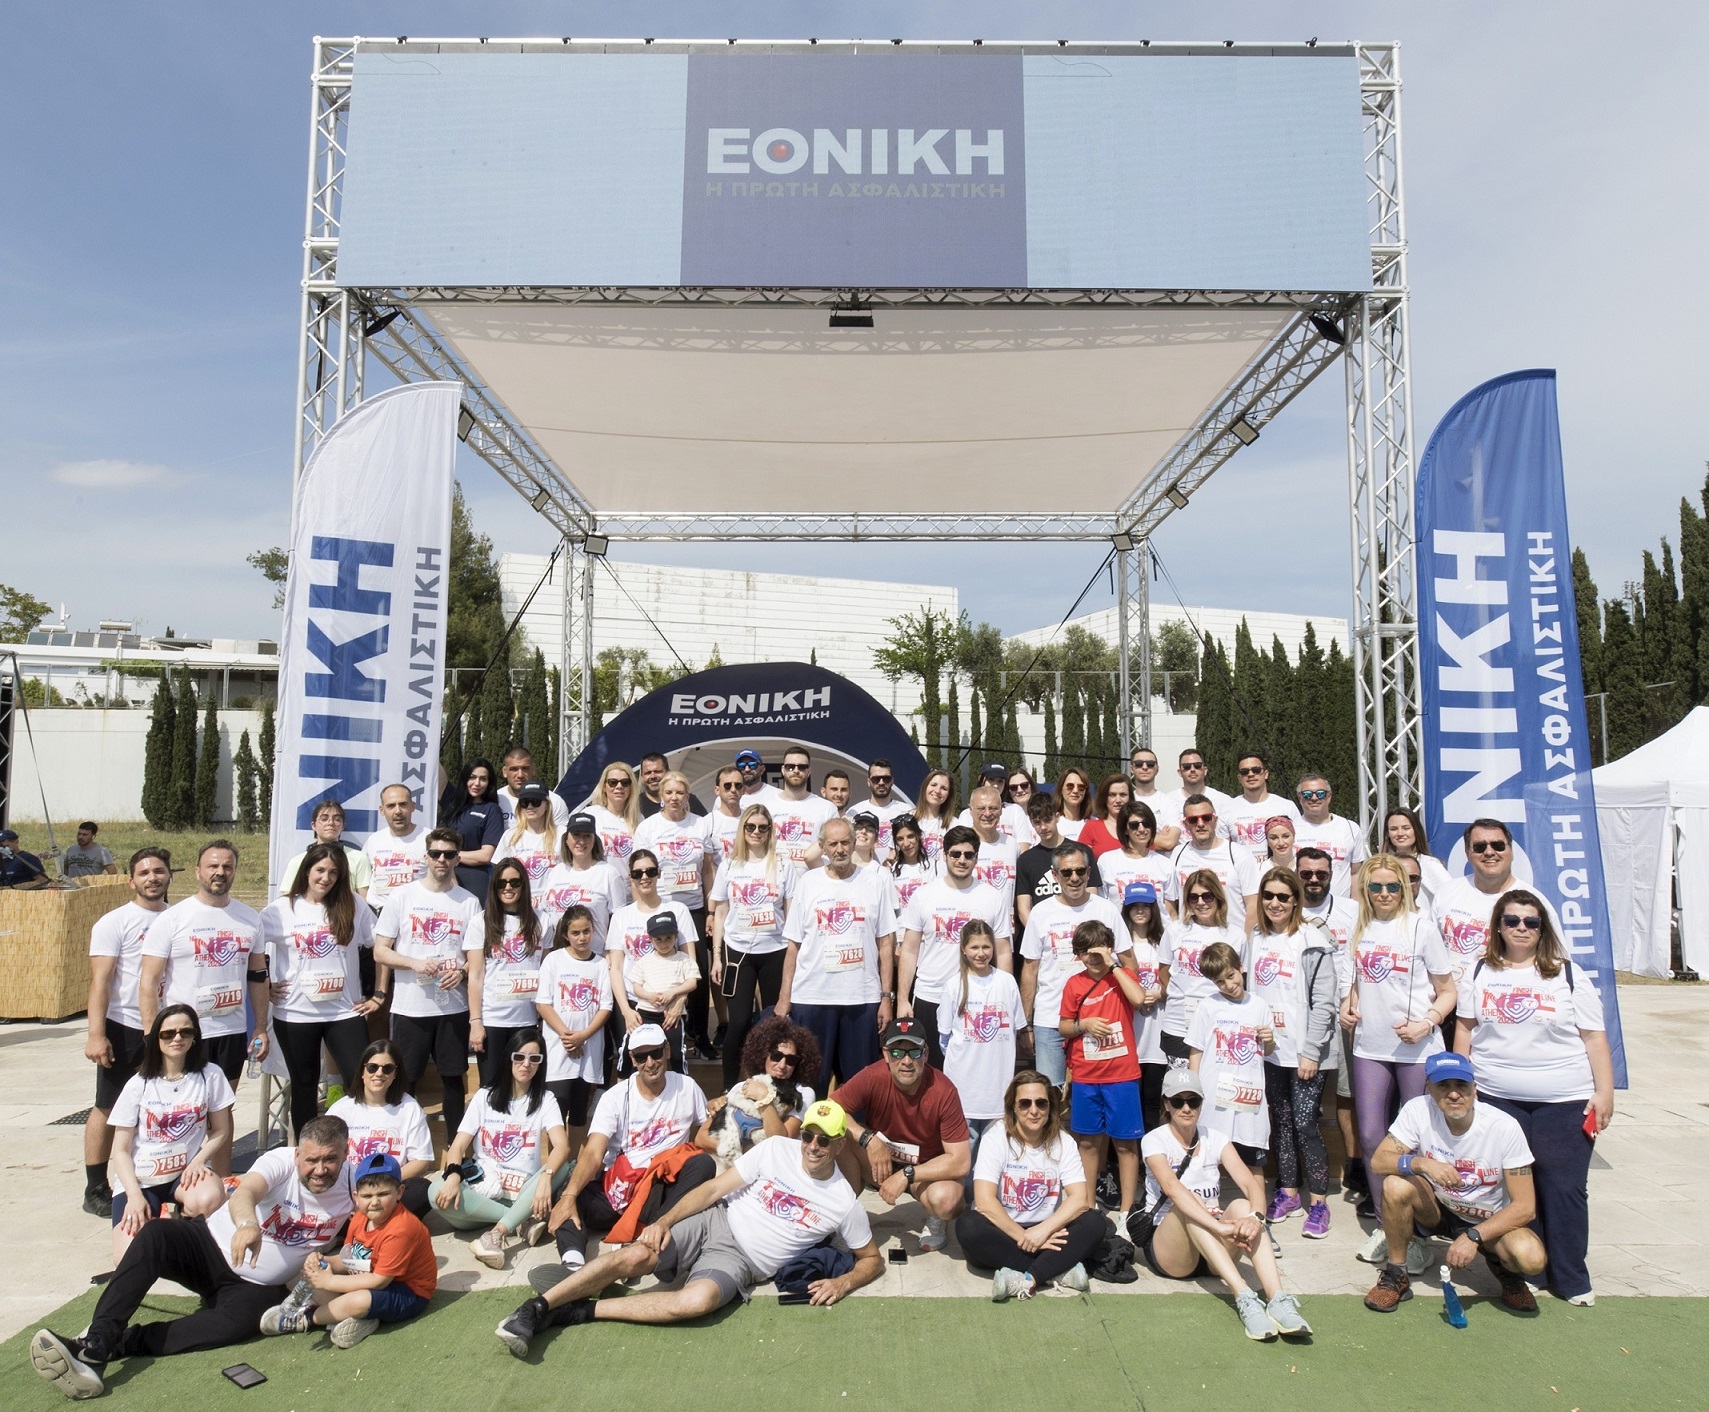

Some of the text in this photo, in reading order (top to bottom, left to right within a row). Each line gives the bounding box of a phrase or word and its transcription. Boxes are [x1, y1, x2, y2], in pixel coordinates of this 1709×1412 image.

[706, 182, 1006, 199] Η ΠΡΩΤΗ ΑΣΦΑΛΙΣΤΙΚΗ
[1526, 531, 1580, 800] ΑΣΦΑΛΙΣΤΙΚΗ
[668, 710, 830, 726] Η ΠΡΩΤΗ ΑΣΦΑΛΙΣΤΙΚΗ
[679, 872, 696, 881] 7691
[517, 979, 538, 989] 7694
[219, 990, 241, 1003] 7719
[1541, 994, 1556, 1002] LINE
[1455, 1160, 1475, 1169] FINISH
[1029, 1171, 1045, 1179] FINISH
[1484, 1168, 1499, 1176] LINE
